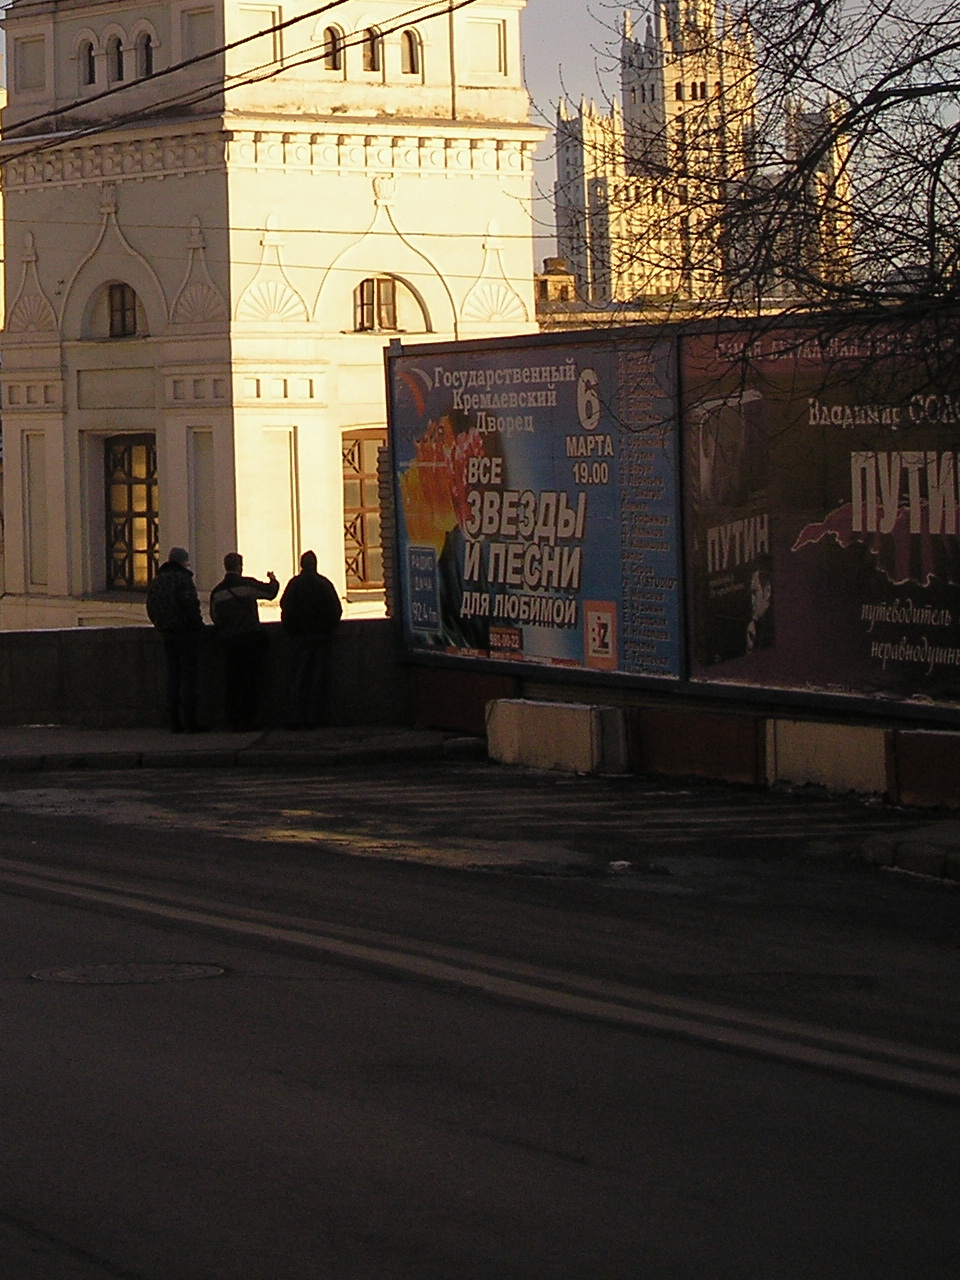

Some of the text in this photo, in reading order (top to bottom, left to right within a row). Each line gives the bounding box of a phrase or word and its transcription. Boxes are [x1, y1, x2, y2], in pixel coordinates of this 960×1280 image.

[434, 357, 577, 391] Государственный
[453, 383, 557, 414] Кремлевский
[577, 368, 601, 431] 6
[476, 412, 535, 437] Дворец
[566, 434, 614, 457] МАРТА
[467, 457, 503, 484] ВСЕ
[573, 462, 609, 484] 19.00
[851, 451, 960, 535] ПУТИ
[467, 490, 586, 545] ЗВЕЗДЫ
[707, 514, 769, 573] ПУТИН
[487, 542, 581, 588] ПЕСНИ
[460, 592, 577, 624] ДЛЯ ЛЮБИМОЙ
[861, 598, 951, 633] путеводитель
